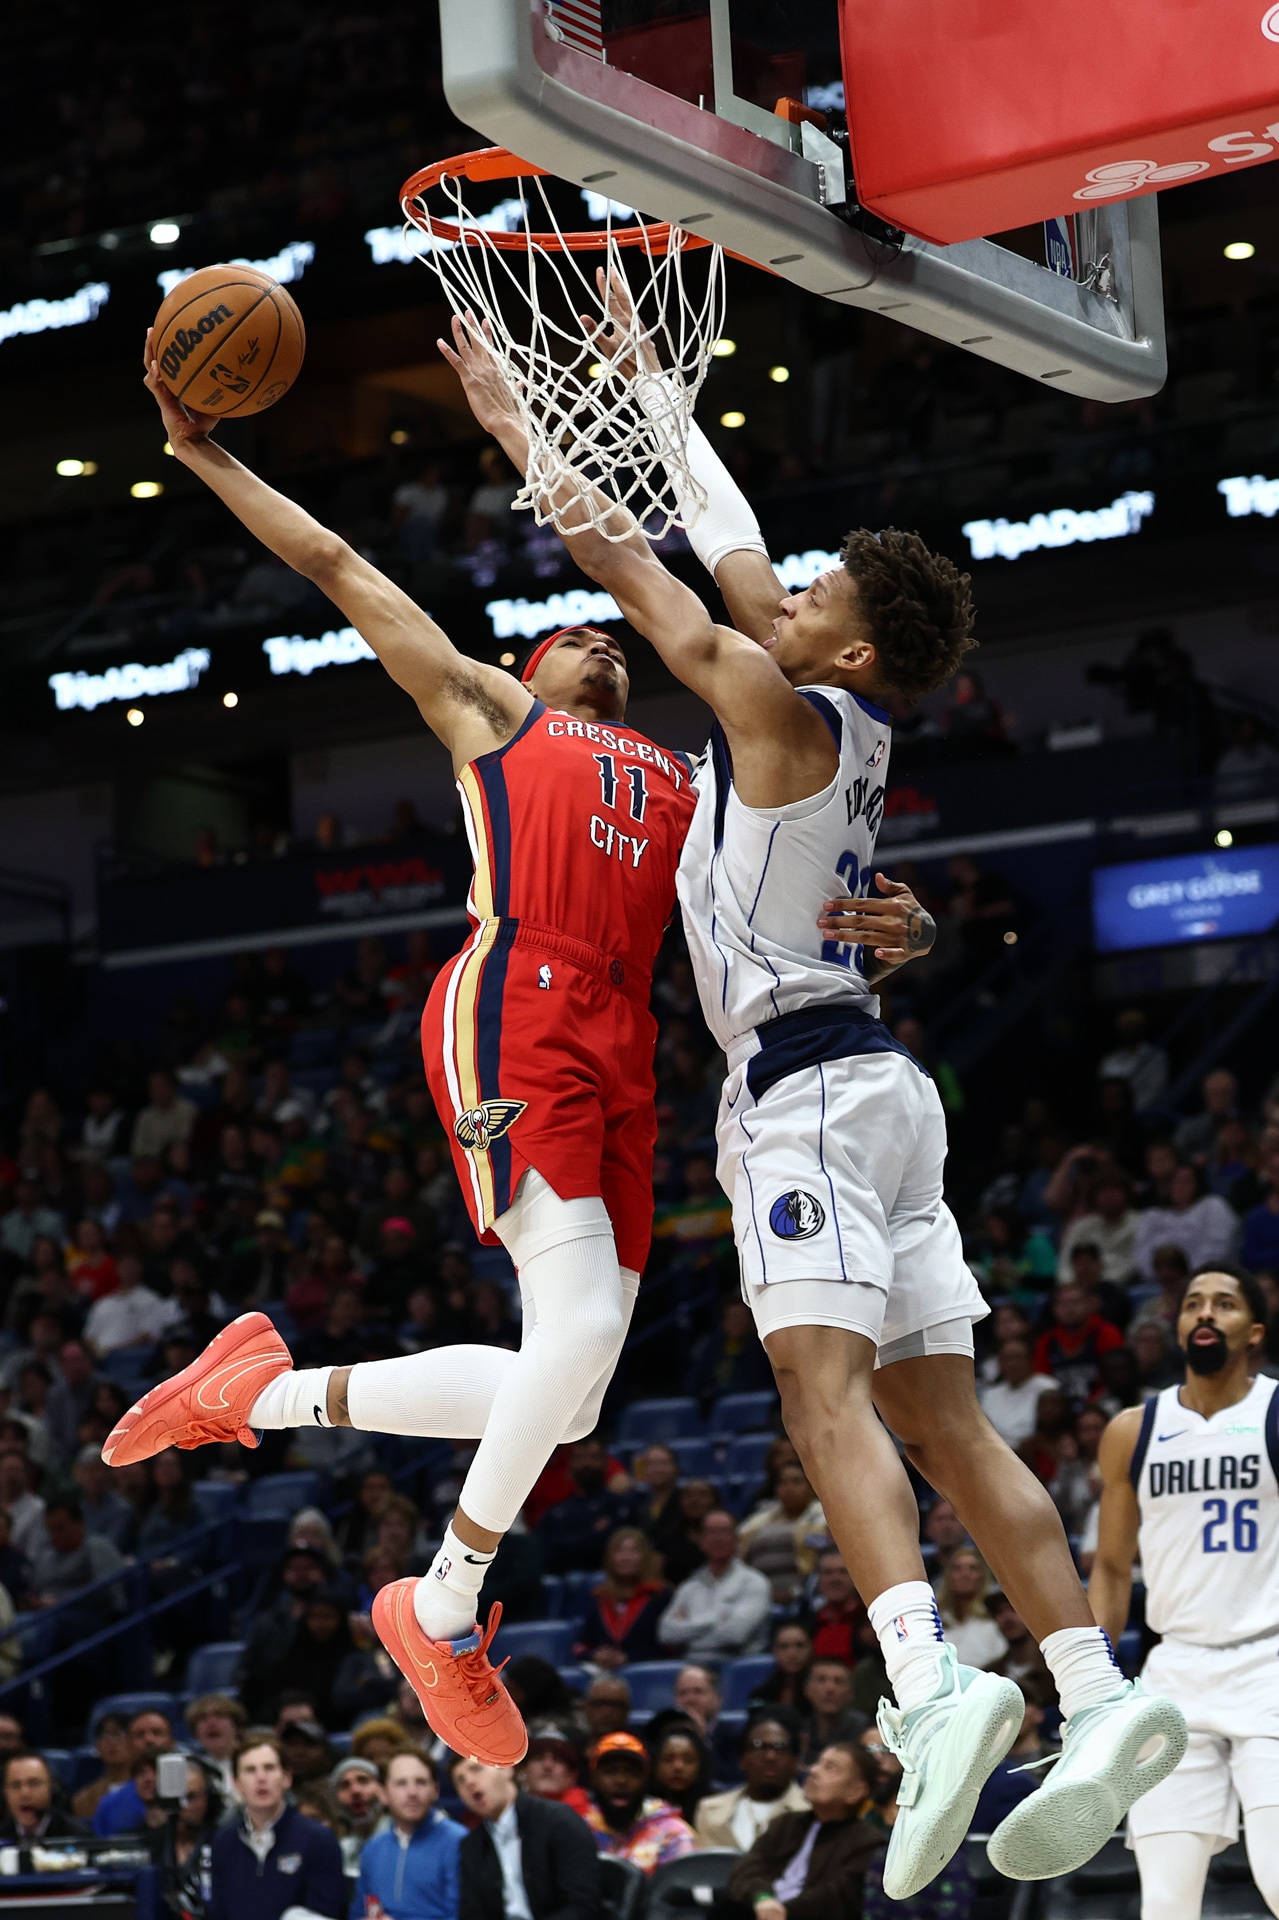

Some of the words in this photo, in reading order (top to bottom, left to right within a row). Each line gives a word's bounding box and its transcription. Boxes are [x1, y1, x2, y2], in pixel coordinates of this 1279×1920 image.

[160, 303, 235, 381] Wilson
[547, 721, 684, 791] CRESCENT
[592, 752, 649, 824] 11
[589, 814, 650, 868] CITY
[1150, 1454, 1260, 1498] DALLAS
[1203, 1498, 1260, 1553] 26
